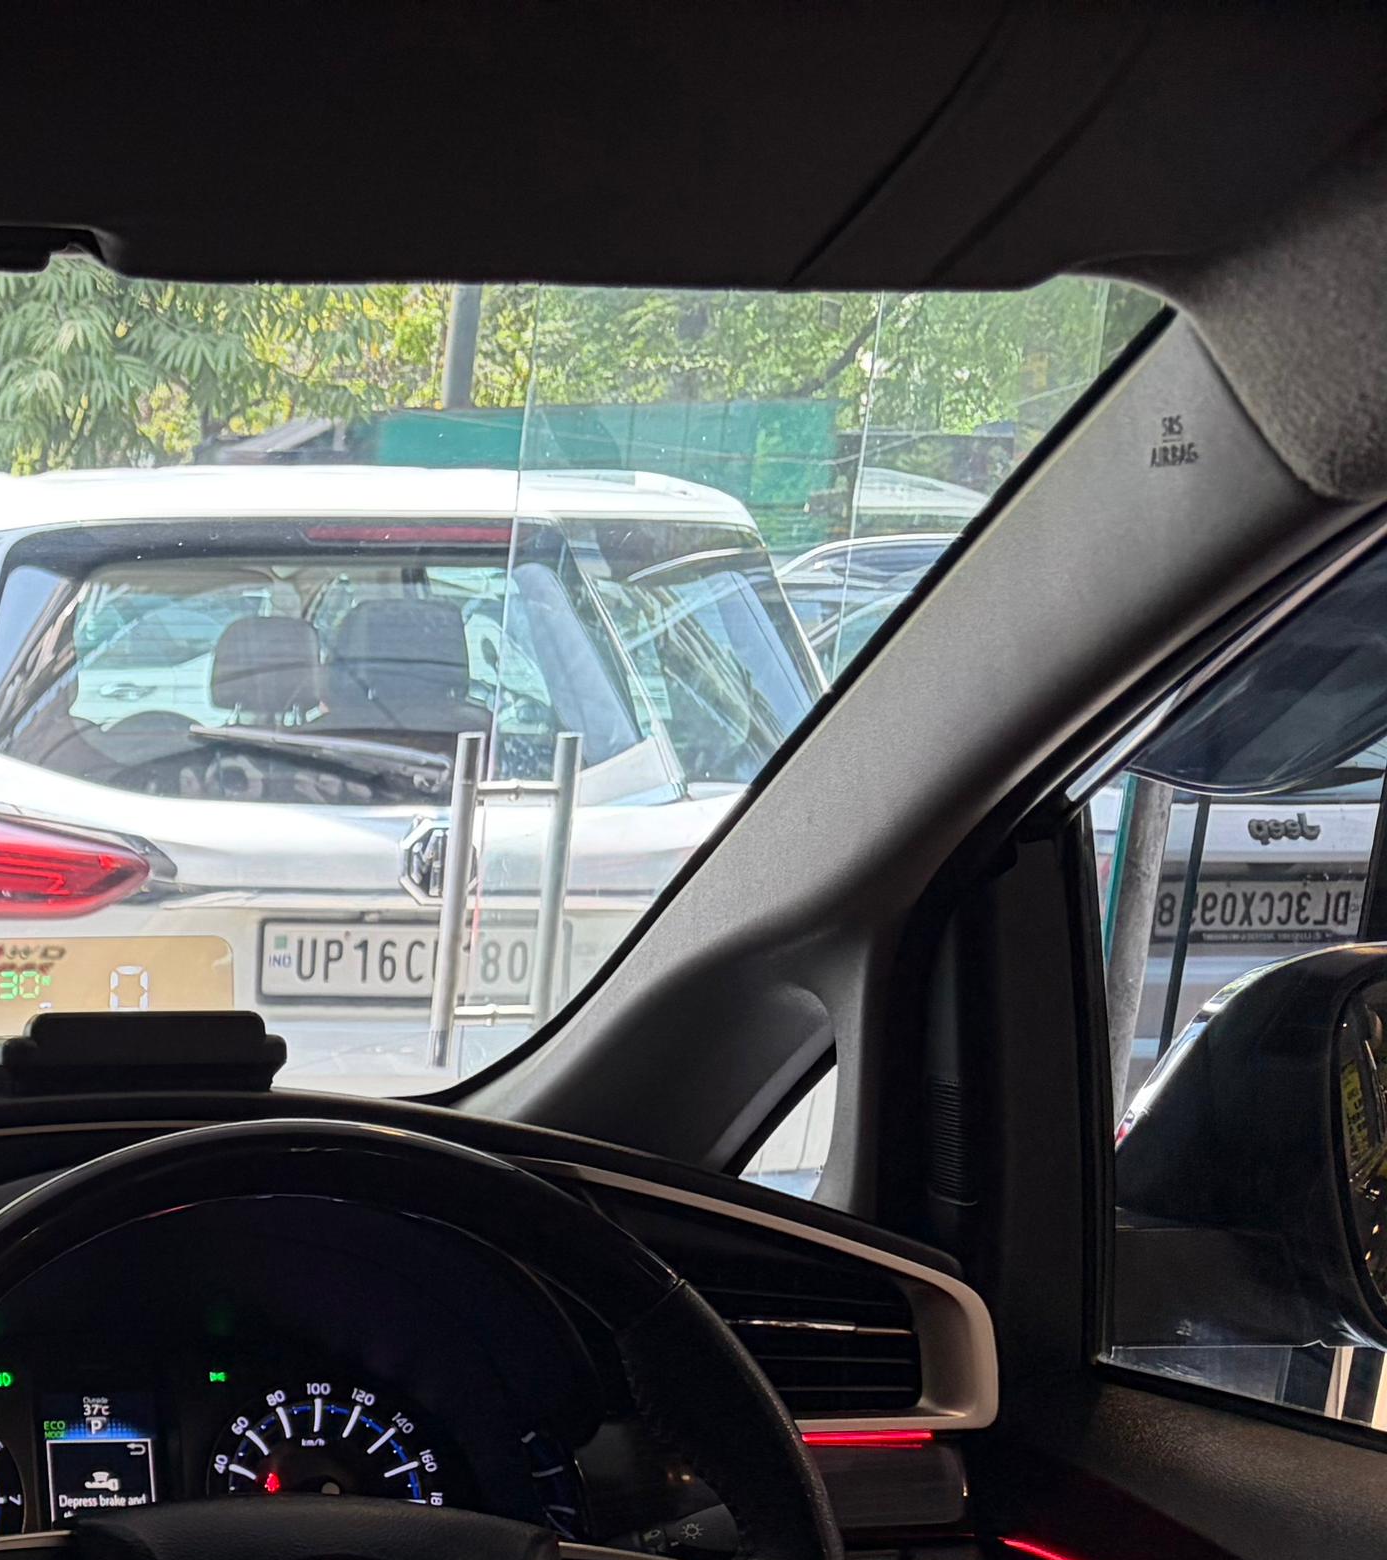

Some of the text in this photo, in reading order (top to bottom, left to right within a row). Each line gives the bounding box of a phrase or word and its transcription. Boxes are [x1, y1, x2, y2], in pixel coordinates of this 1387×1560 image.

[1150, 442, 1199, 467] AIRBAG
[266, 1389, 287, 1407] 80
[306, 1382, 331, 1396] 100
[351, 1387, 376, 1407] 120
[44, 1421, 66, 1431] ECO
[91, 1420, 103, 1434] P
[230, 1415, 250, 1435] 60
[390, 1411, 415, 1435] 140
[300, 1437, 325, 1447] km/h
[213, 1453, 229, 1476] 40
[418, 1448, 438, 1473] 160
[8, 1493, 22, 1505] 7
[58, 1493, 147, 1508] Depress brake and
